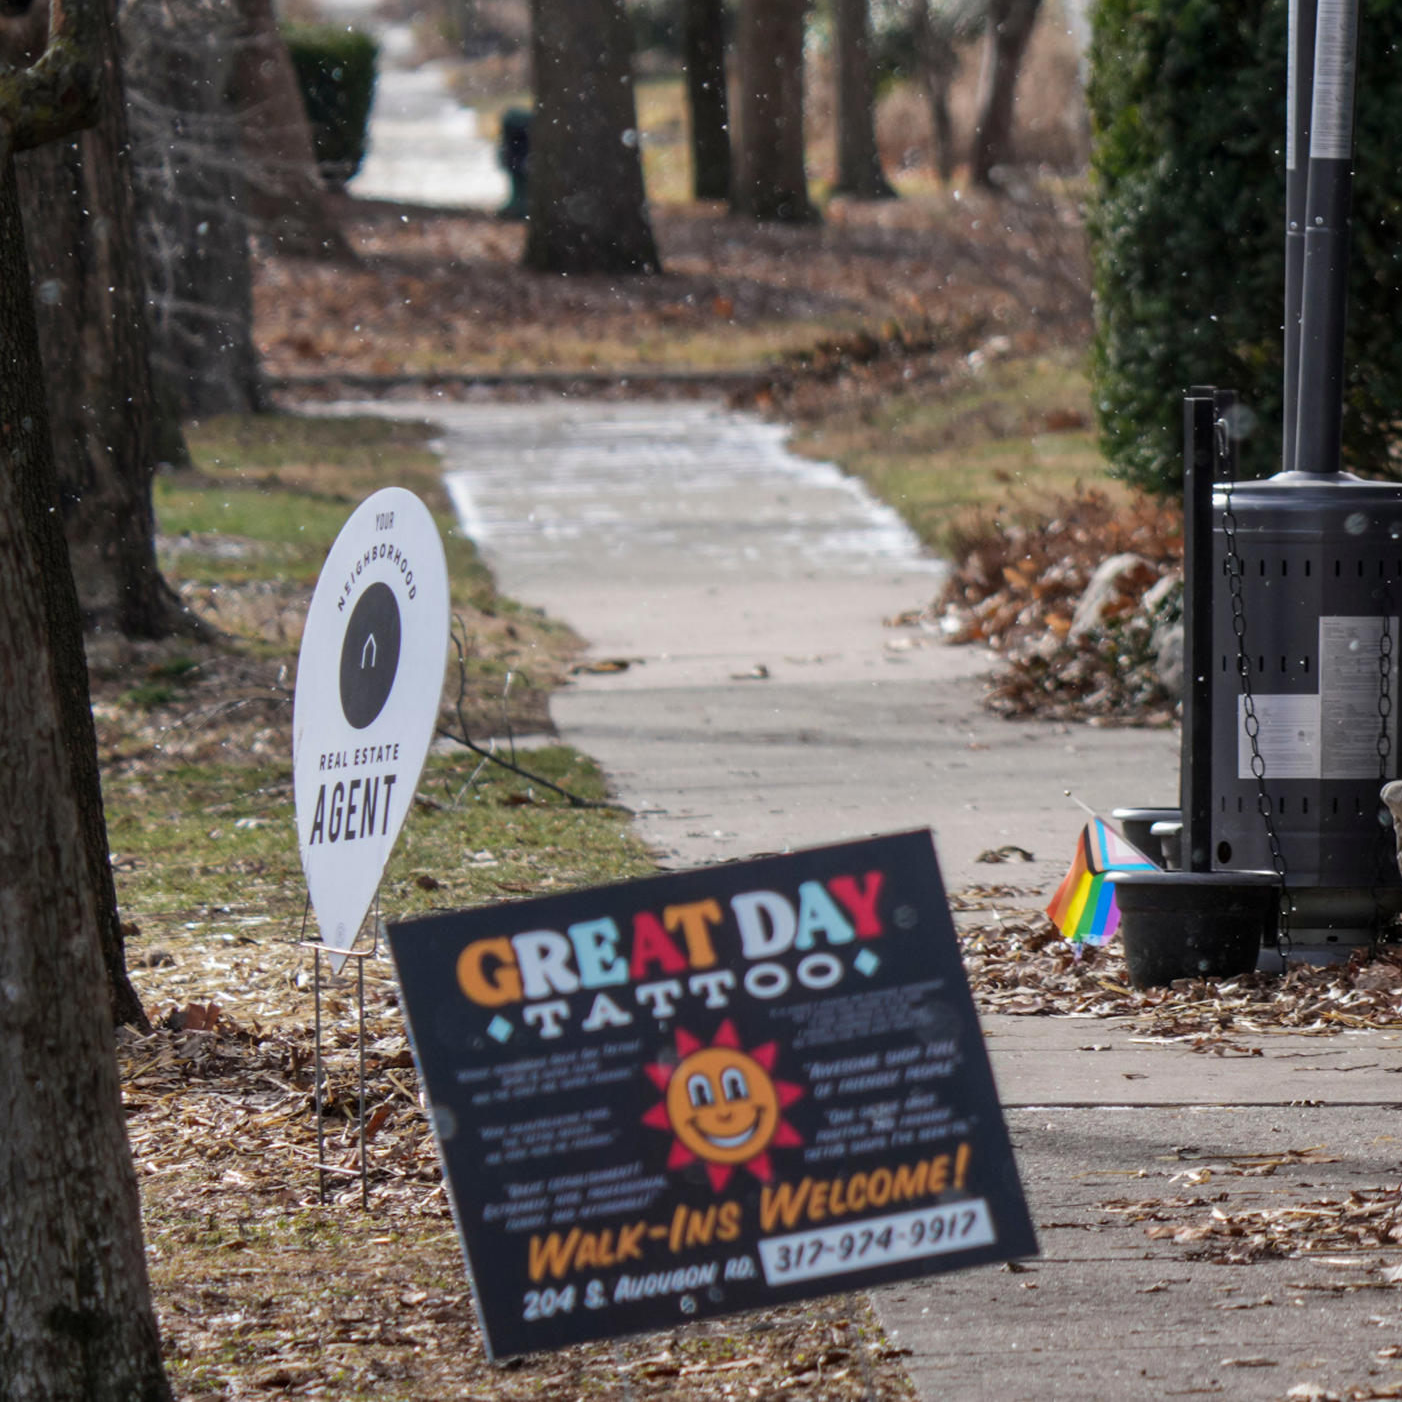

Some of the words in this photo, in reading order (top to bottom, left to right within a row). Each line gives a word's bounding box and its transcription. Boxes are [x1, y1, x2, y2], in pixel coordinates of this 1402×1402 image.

[374, 509, 395, 532] YOUR
[337, 542, 417, 612] NEIGHBORHOOD
[318, 748, 349, 771] REAL
[354, 742, 400, 767] ESTATE
[309, 773, 397, 846] AGENT
[455, 897, 724, 1009] GREAT
[730, 871, 885, 961] DAY
[524, 951, 845, 1040] TATTOO
[527, 1201, 742, 1283] WALK-INS
[758, 1142, 972, 1233] WELCOME!
[775, 1211, 977, 1272] 317-974-9917
[521, 1285, 577, 1322] 204
[583, 1278, 608, 1310] S.
[614, 1261, 719, 1300] AUDUBON
[722, 1254, 758, 1283] RD.
